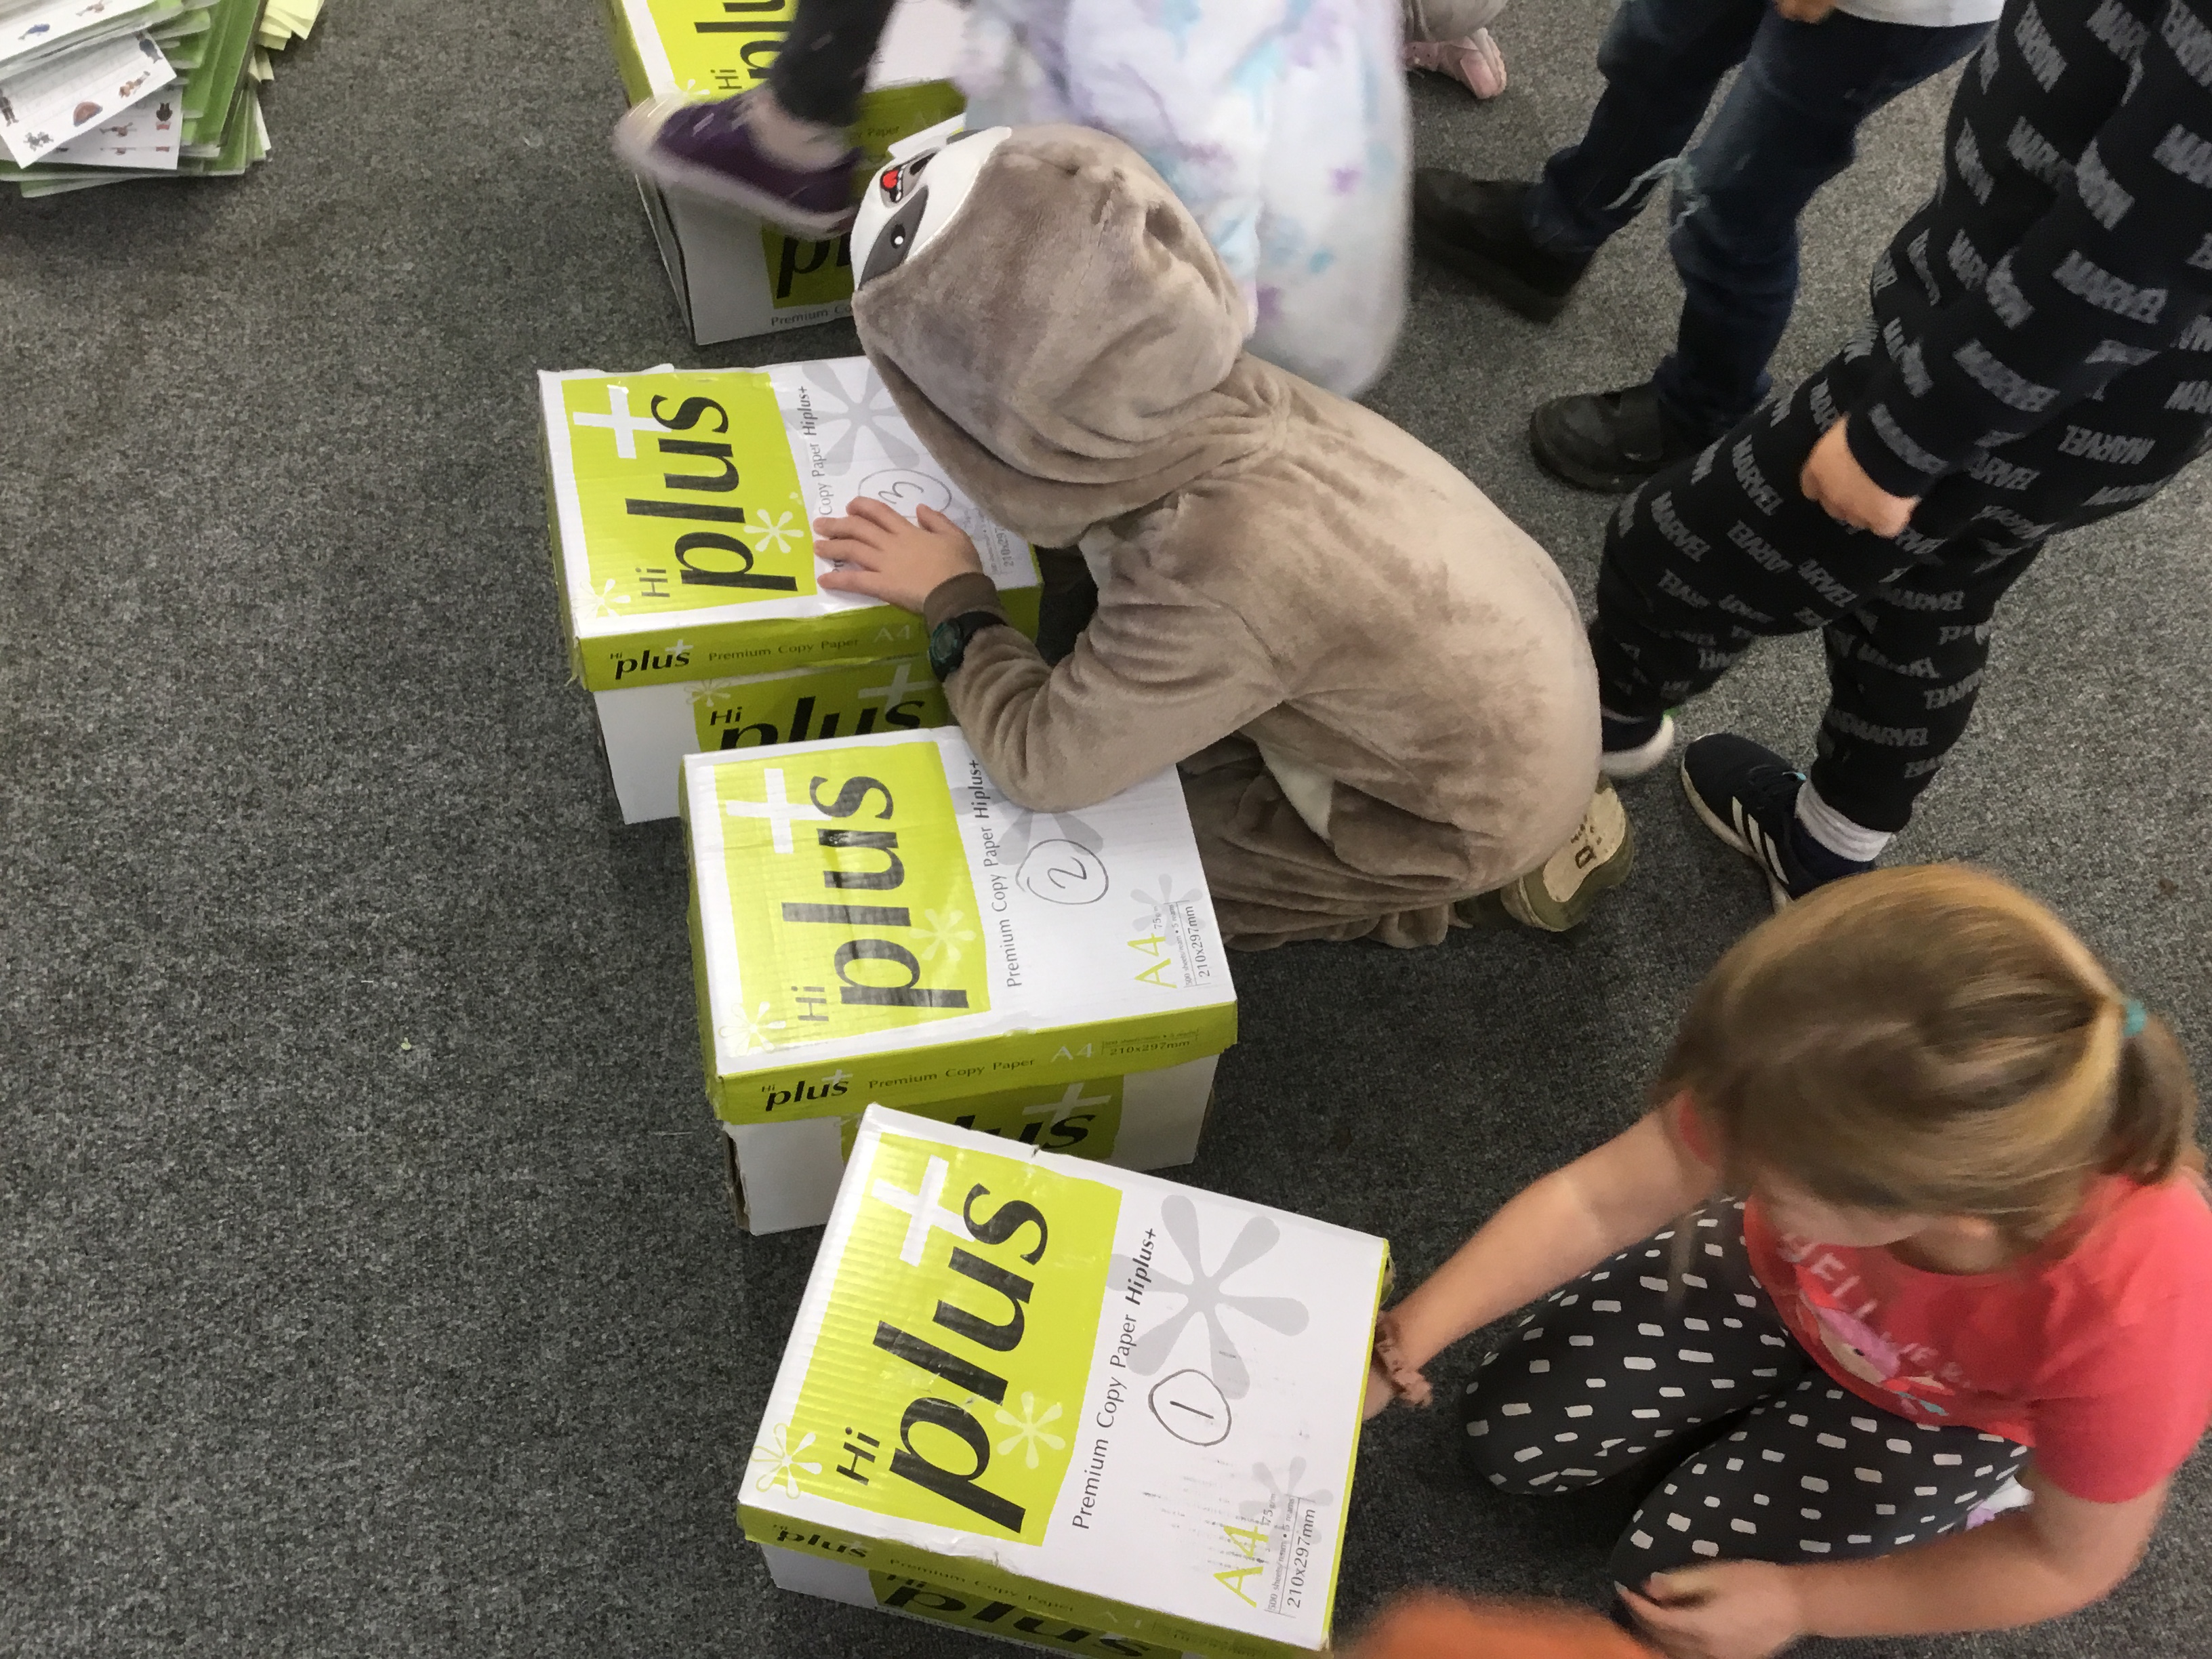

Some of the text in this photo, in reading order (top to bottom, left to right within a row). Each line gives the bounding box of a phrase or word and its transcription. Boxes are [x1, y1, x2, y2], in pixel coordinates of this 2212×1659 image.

[710, 69, 743, 89] Hi
[771, 309, 829, 326] Premium
[797, 386, 834, 516] Copy Paper Hiplus+
[2057, 424, 2156, 465] MARVEL
[624, 394, 798, 592] plus
[1732, 434, 1784, 517] MARVEL
[1650, 490, 1712, 562] MARVEL
[635, 567, 670, 598] Hi
[1797, 558, 1859, 609] ARVEL
[610, 651, 623, 660] Hi
[615, 649, 691, 680] plus
[709, 623, 912, 661] Premium Copy Paper A4
[710, 706, 743, 726] Hi
[781, 775, 970, 1009] plus
[968, 759, 1023, 987] Premium Copy Paper Hiplus+
[1047, 856, 1087, 888] 2
[1127, 933, 1177, 989] A4
[1185, 905, 1210, 978] 210x297mm
[790, 985, 830, 1023] Hi
[868, 1043, 1093, 1089] Premium Copy Paper A4
[765, 1080, 850, 1111] plus
[872, 1181, 1049, 1534] plus
[1072, 1227, 1158, 1530] Premium Copy Paper Hiplus+
[836, 1426, 882, 1486] Hi
[777, 1530, 869, 1558] plus
[1213, 1525, 1269, 1608] A4
[1287, 1509, 1316, 1609] 210x297mm
[884, 1585, 1151, 1658] plus
